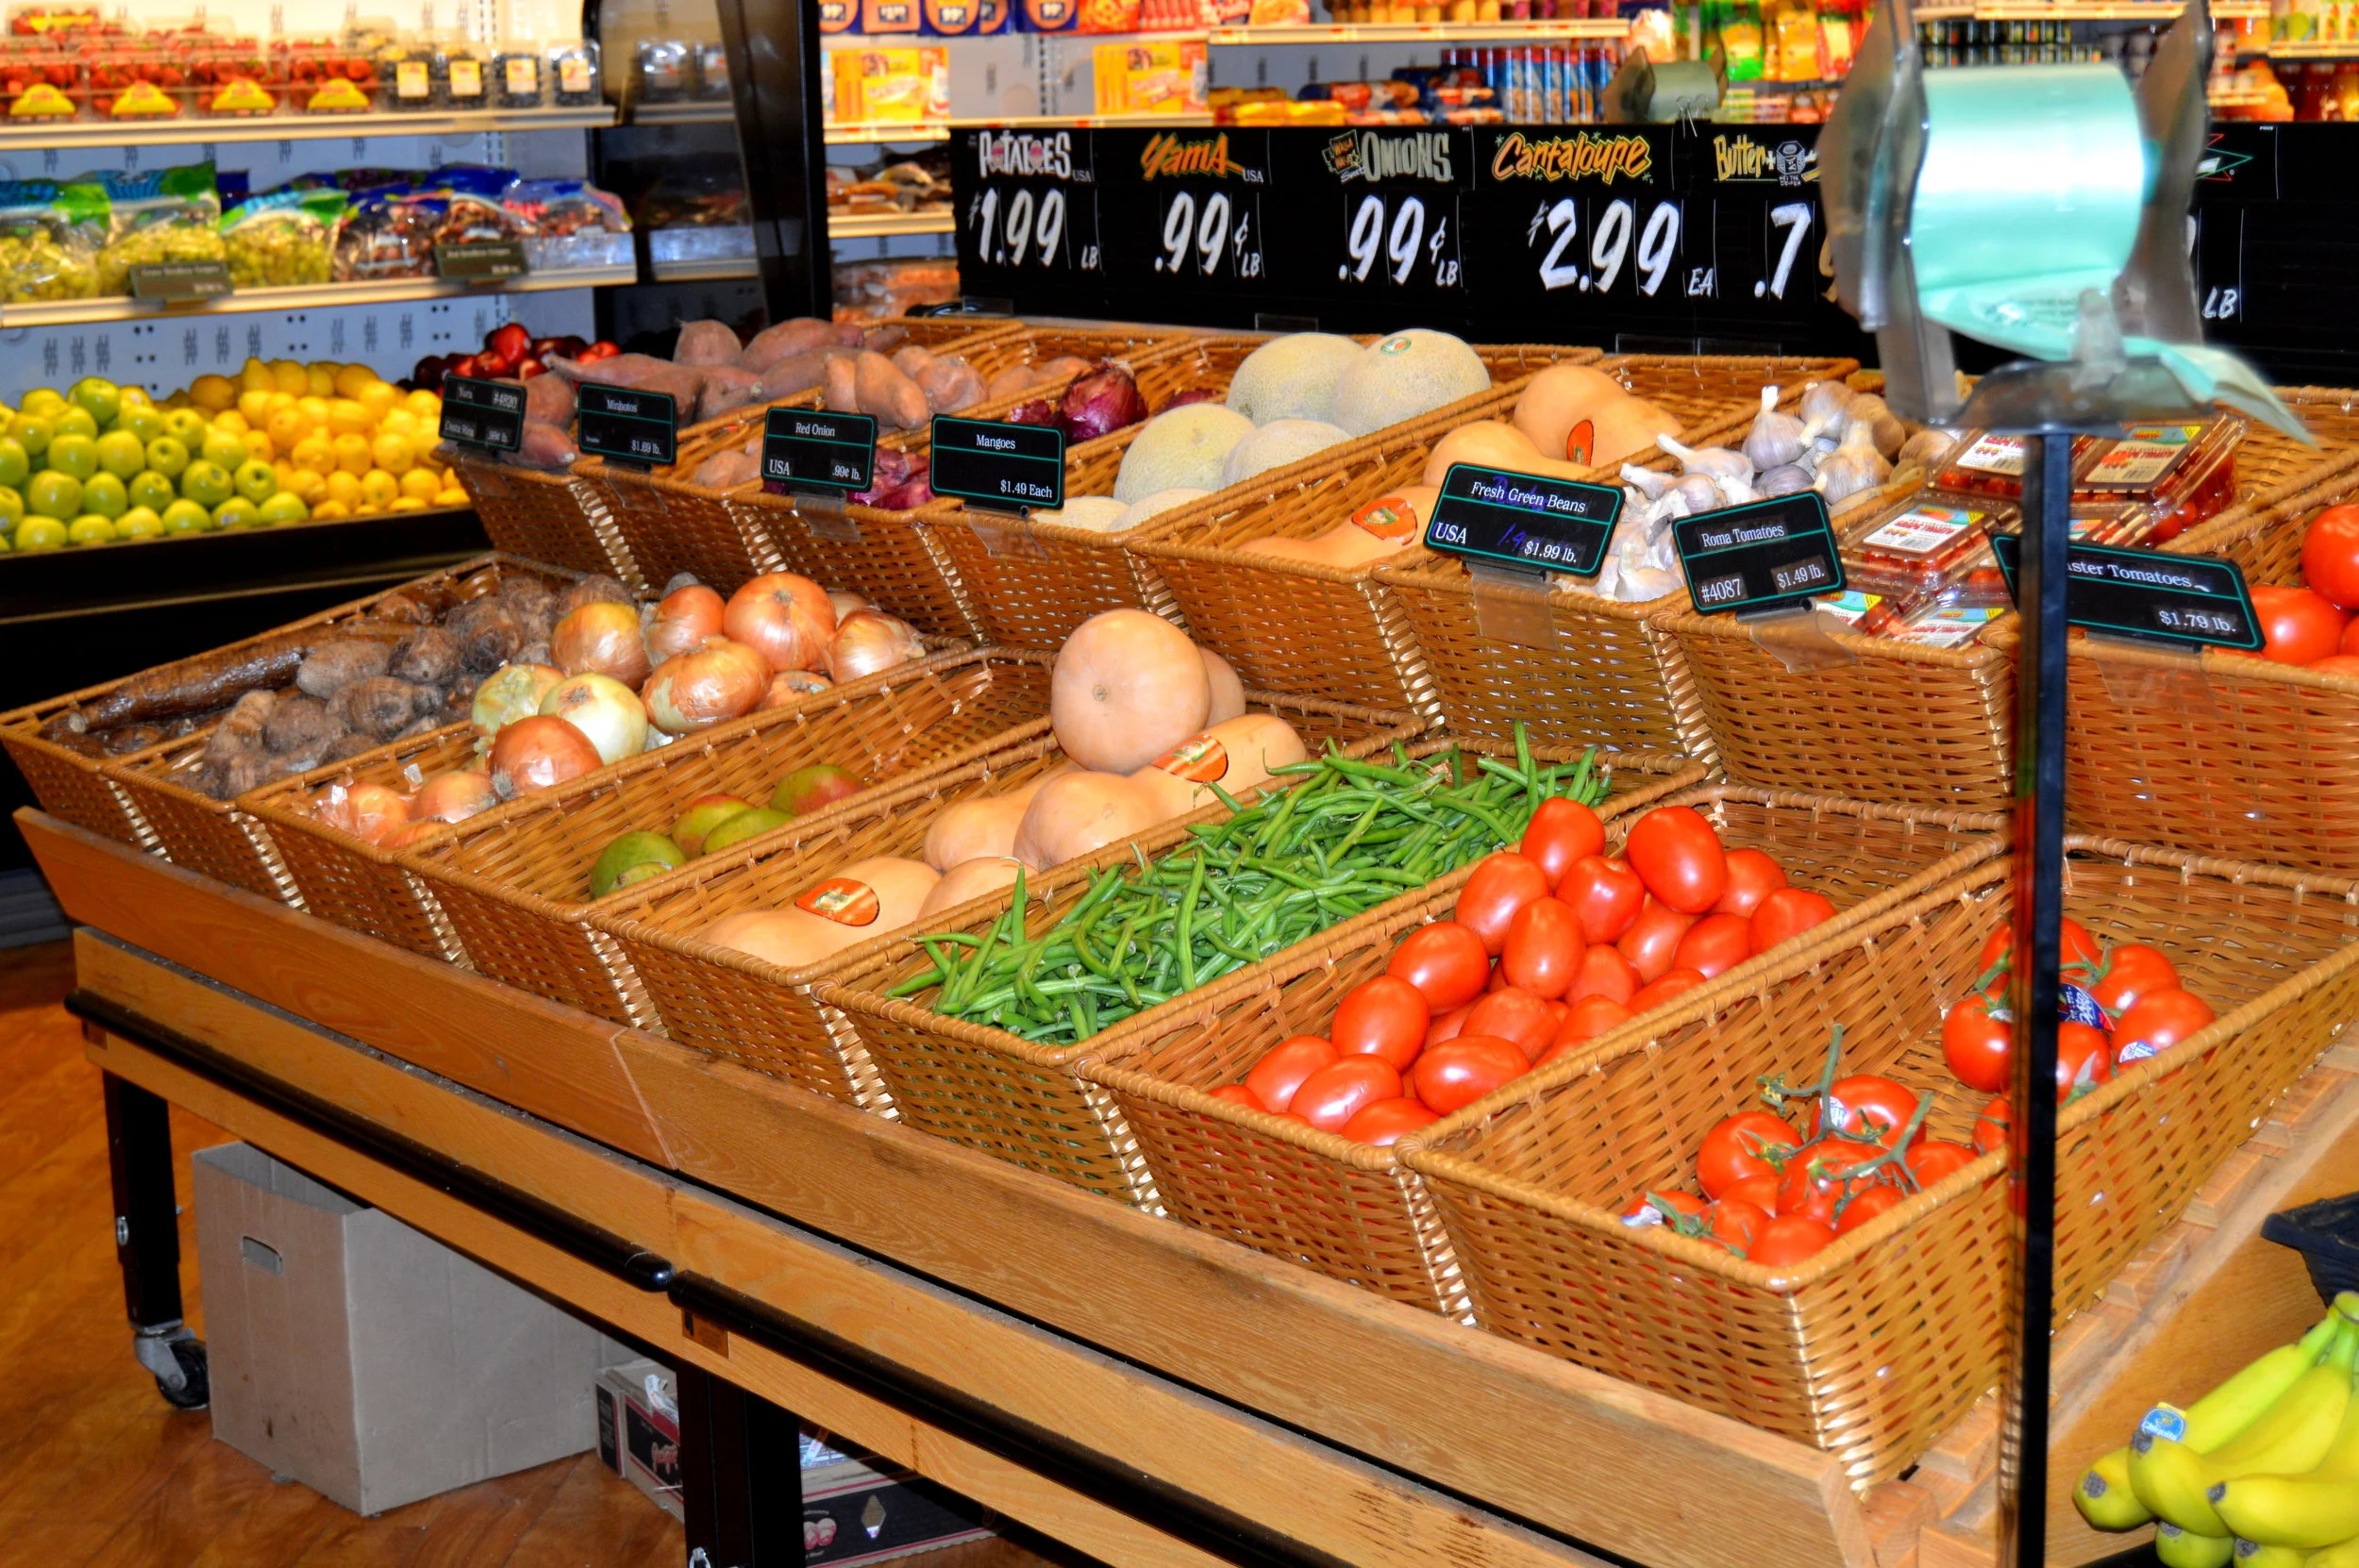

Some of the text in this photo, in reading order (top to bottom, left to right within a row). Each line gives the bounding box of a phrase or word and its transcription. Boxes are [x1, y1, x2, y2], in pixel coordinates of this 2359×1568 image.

[979, 129, 1072, 179] POTATOES
[1492, 132, 1651, 185] Cantaloupe
[1072, 169, 1093, 182] USA
[1242, 168, 1264, 183] USA
[968, 187, 1098, 270] $1.99 LB
[1527, 198, 1714, 297] $2.99 EA
[1241, 252, 1261, 278] LB
[1435, 259, 1458, 286] LB
[2201, 285, 2239, 320] LB
[795, 422, 835, 437] Red Onion
[976, 434, 1016, 450] Mangoes
[769, 459, 791, 475] USA
[851, 467, 862, 480] lb.
[1000, 479, 1053, 498] $1.49 Each
[1470, 480, 1506, 501] Fresh
[1508, 488, 1545, 507] Green
[1547, 494, 1586, 513] Beans
[1434, 522, 1468, 544] USA
[1701, 525, 1785, 548] Roma Tomatoes
[1524, 540, 1578, 563] $1.99 lb.
[1777, 563, 1825, 590] $1.49 lb.
[2107, 563, 2192, 588] Tomatoes
[1701, 577, 1742, 603] #4087
[2159, 610, 2236, 633] $1.79 lb.
[2141, 1419, 2178, 1442] Chiquita
